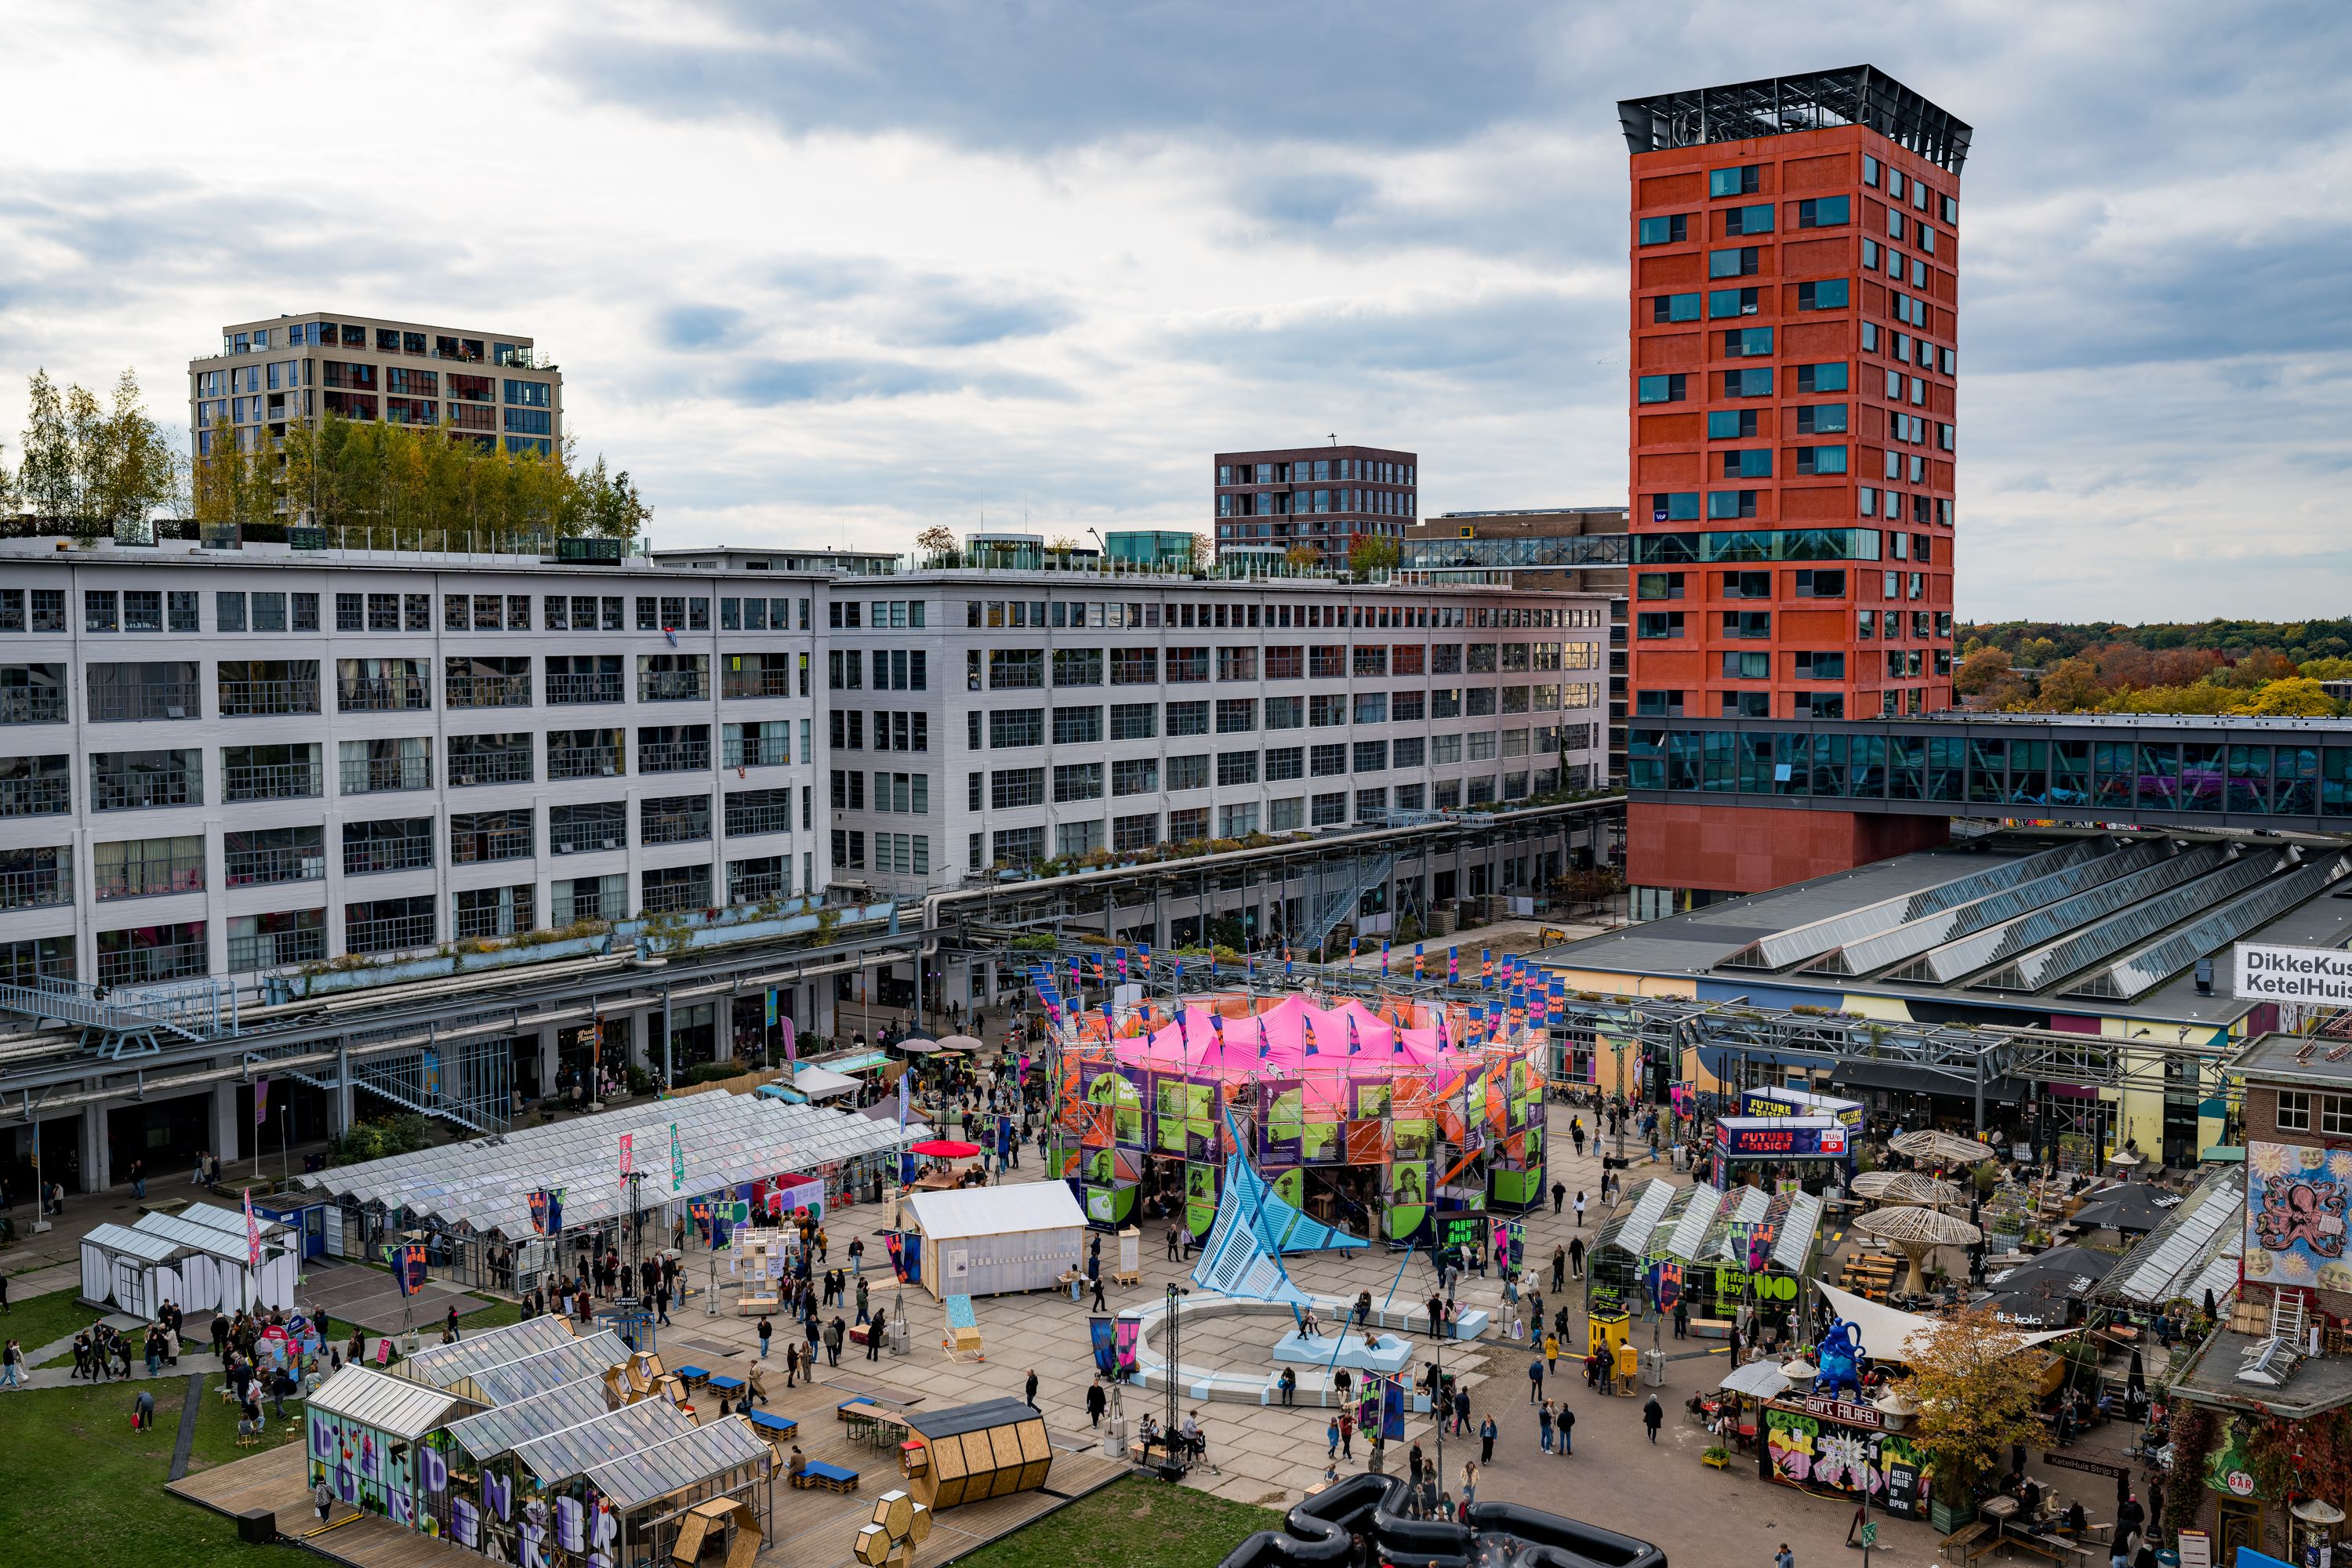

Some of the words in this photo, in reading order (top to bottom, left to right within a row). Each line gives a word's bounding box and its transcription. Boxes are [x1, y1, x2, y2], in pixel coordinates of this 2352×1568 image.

[1750, 1099, 1791, 1116] FUTURE
[1838, 1109, 1862, 1121] FUTURE
[1741, 1133, 1794, 1142] FUTURE
[1748, 1142, 1791, 1151] DESIGN
[1715, 1268, 1754, 1284] Unfar
[1715, 1279, 1743, 1295] Play
[1808, 1399, 1833, 1416] GUY'S
[1837, 1404, 1877, 1424] FALAFEL
[2052, 1457, 2089, 1471] KetelHuis
[2090, 1465, 2112, 1476] Strijp
[2113, 1468, 2119, 1477] S
[1892, 1469, 1913, 1481] KETEL
[1891, 1477, 1909, 1488] HUIS
[2230, 1476, 2252, 1490] BAR
[1890, 1488, 1898, 1497] IS
[1889, 1498, 1908, 1511] OPEN
